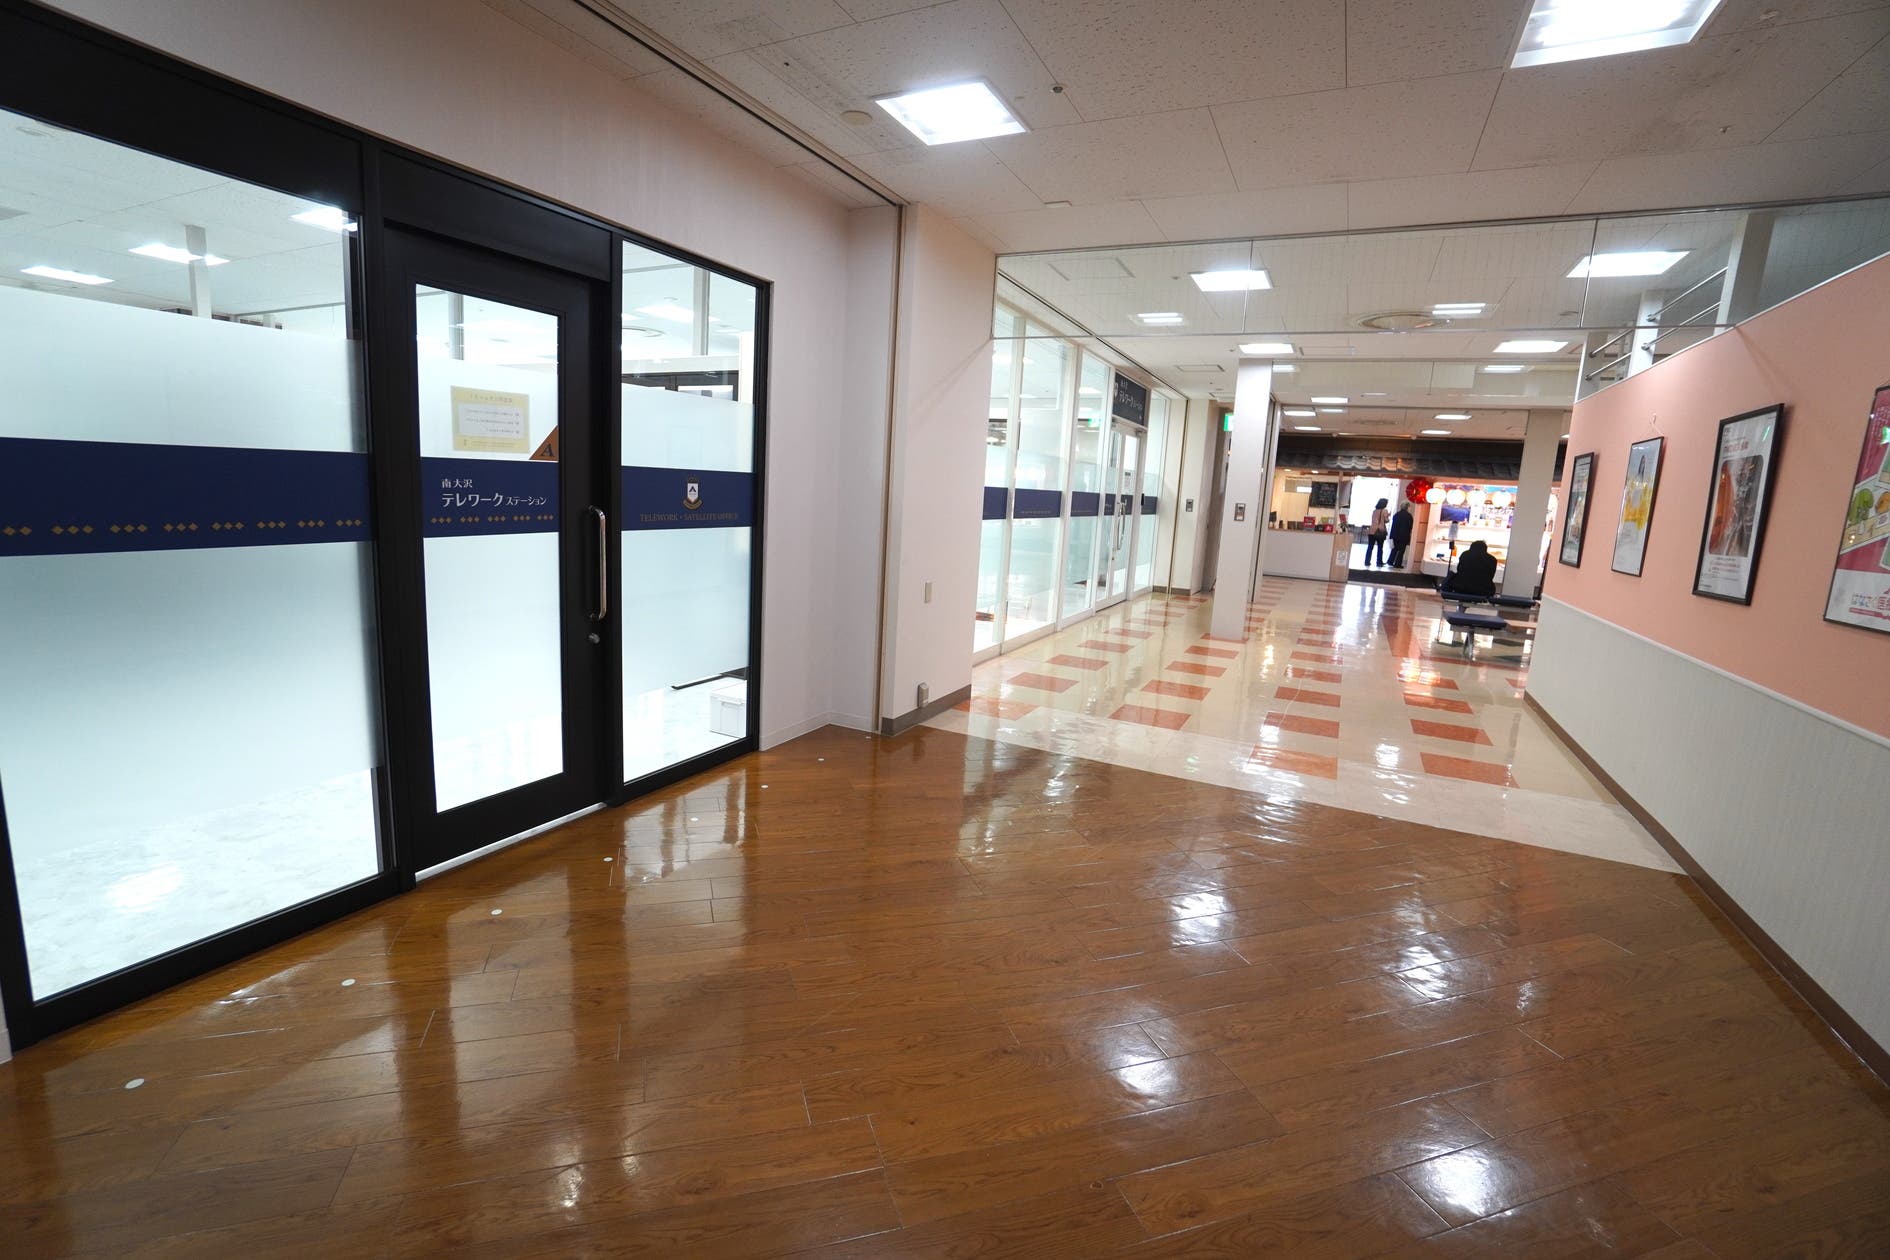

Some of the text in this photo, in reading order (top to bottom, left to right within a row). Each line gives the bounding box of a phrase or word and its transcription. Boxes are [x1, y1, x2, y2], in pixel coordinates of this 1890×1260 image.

[441, 478, 473, 489] 南大沢
[640, 512, 678, 522] TELEWORK
